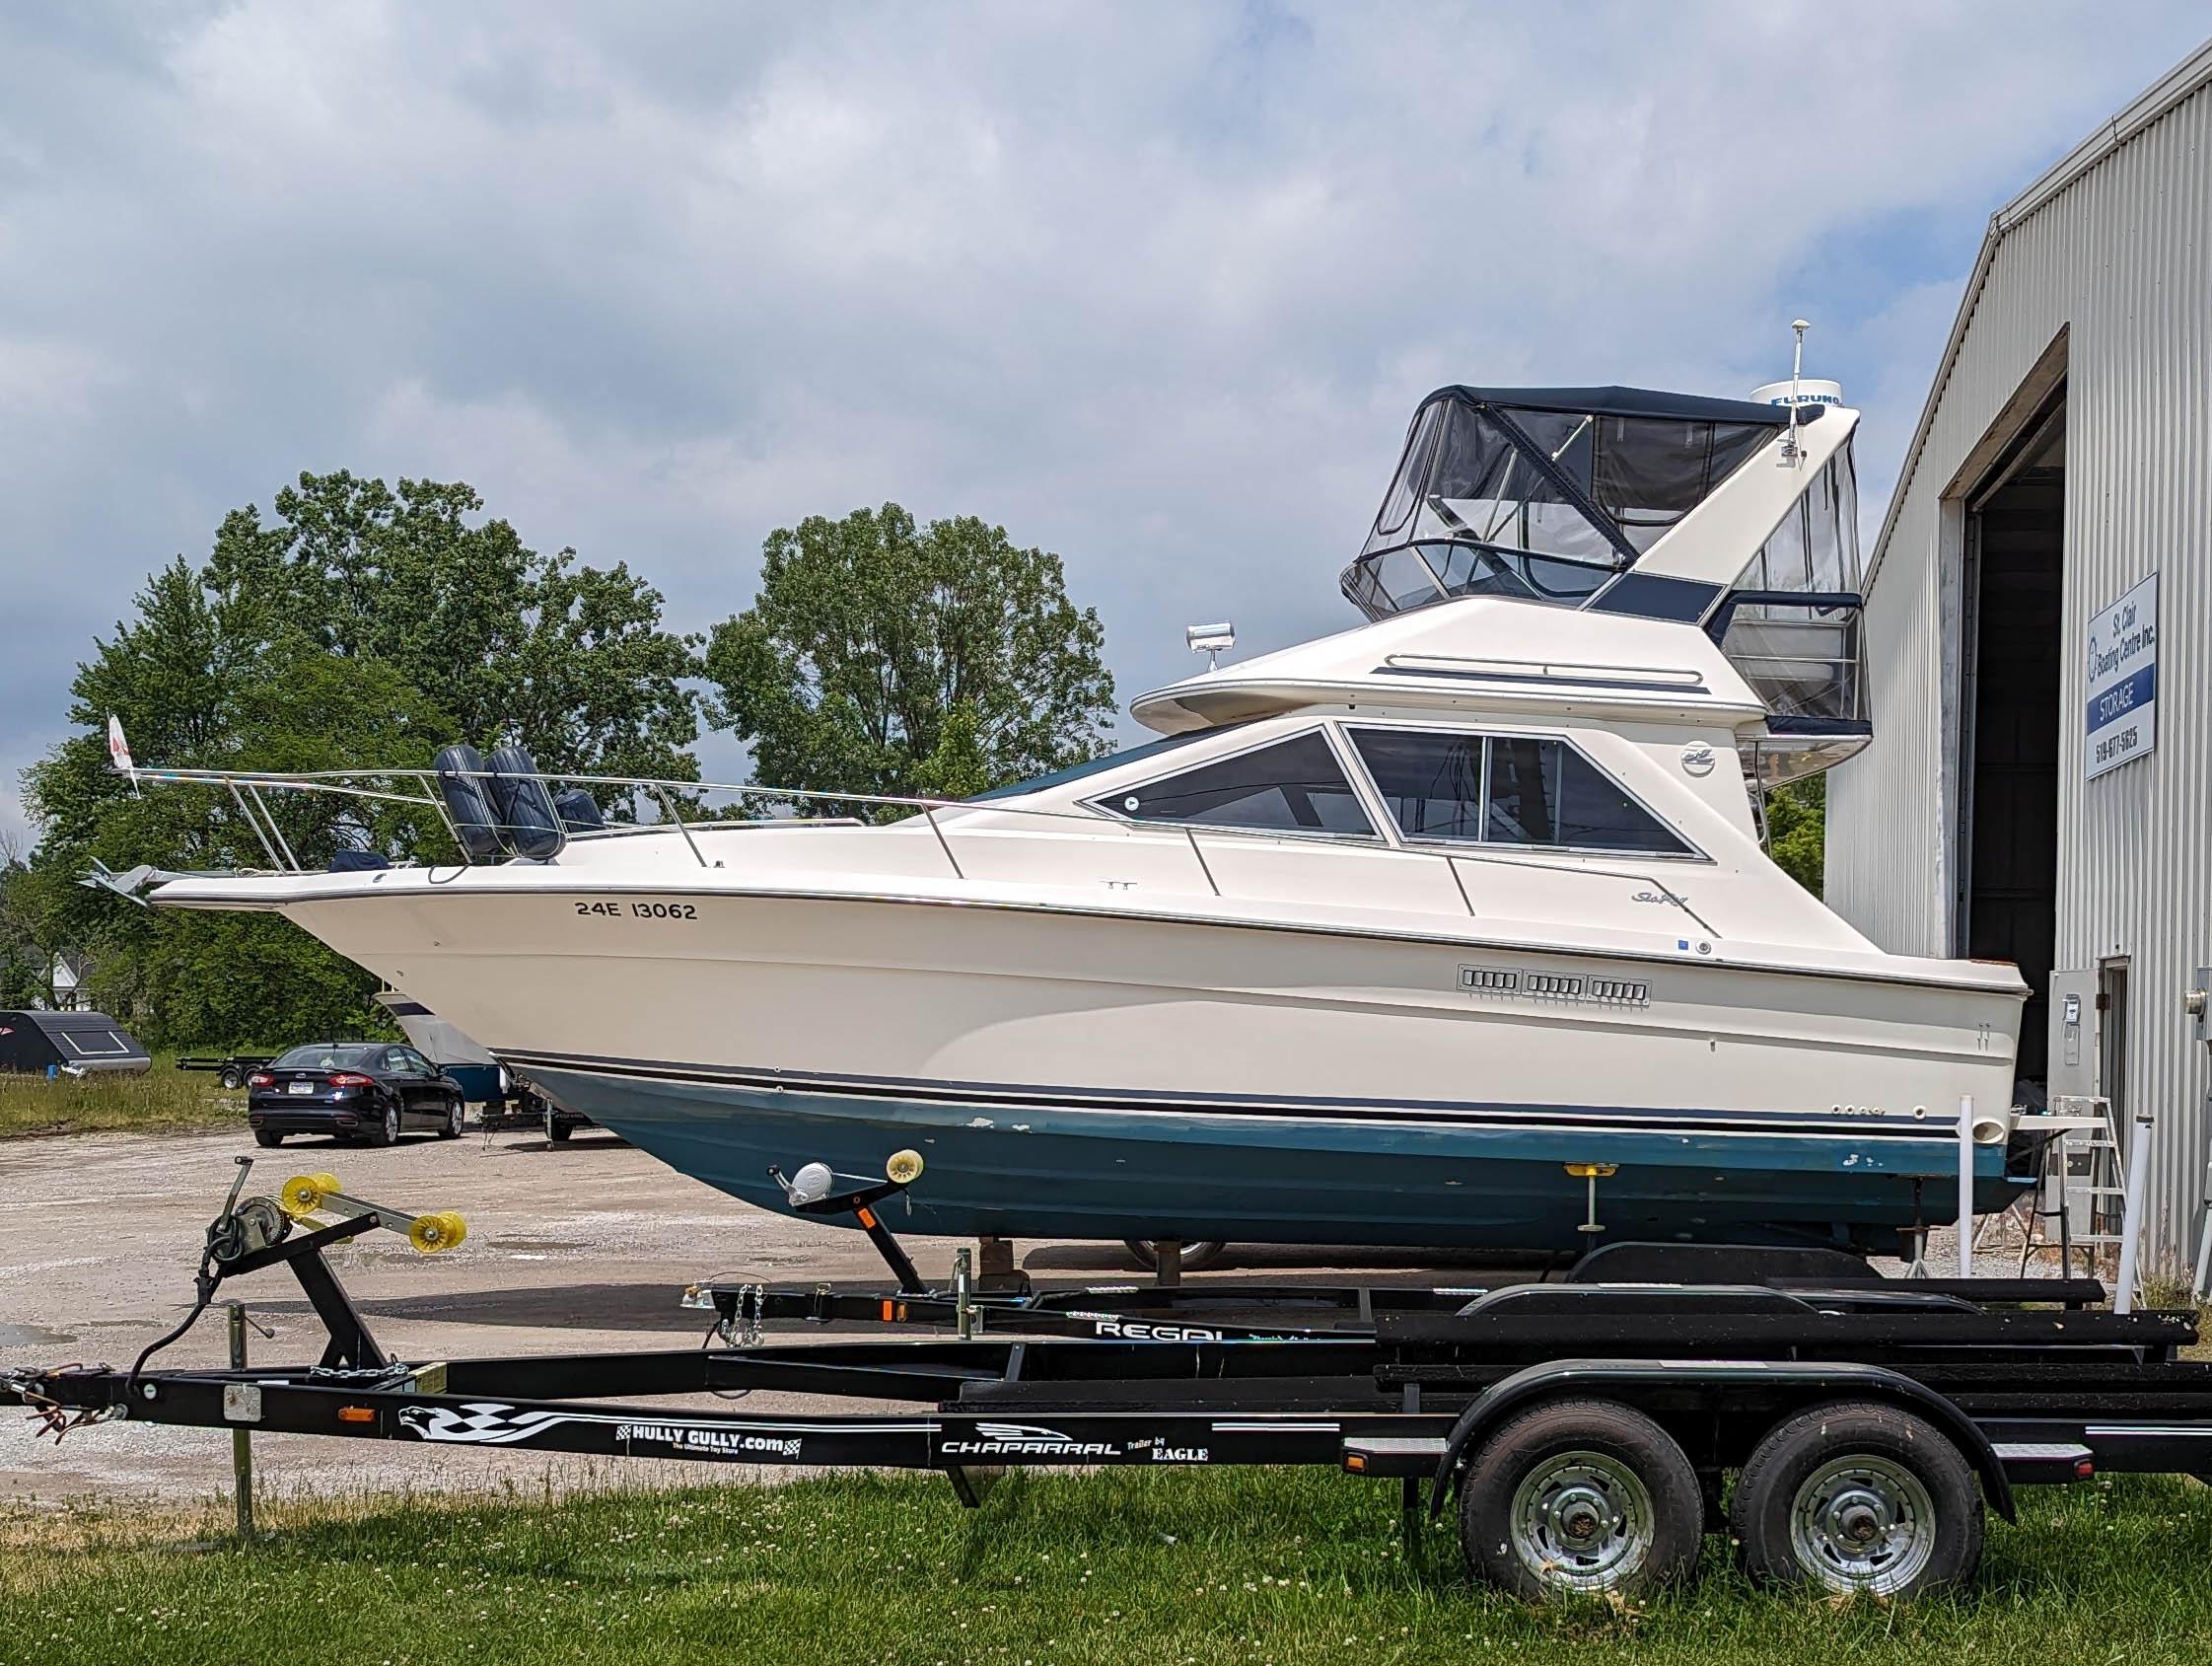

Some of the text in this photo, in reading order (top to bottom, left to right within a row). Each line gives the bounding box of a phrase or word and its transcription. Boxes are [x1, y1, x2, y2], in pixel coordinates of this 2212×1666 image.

[2121, 601, 2137, 631] Clair
[2097, 623, 2155, 678] Boating Centre Inc.
[2099, 681, 2134, 722] STORAGE
[574, 902, 698, 920] 24E 13062
[633, 1425, 784, 1452] HULLY GULLY.com
[1127, 1436, 1166, 1451] Trailer by
[710, 1445, 721, 1455] Toy
[941, 1442, 1122, 1456] CHAPARRAL
[1151, 1447, 1209, 1462] EAGLE
